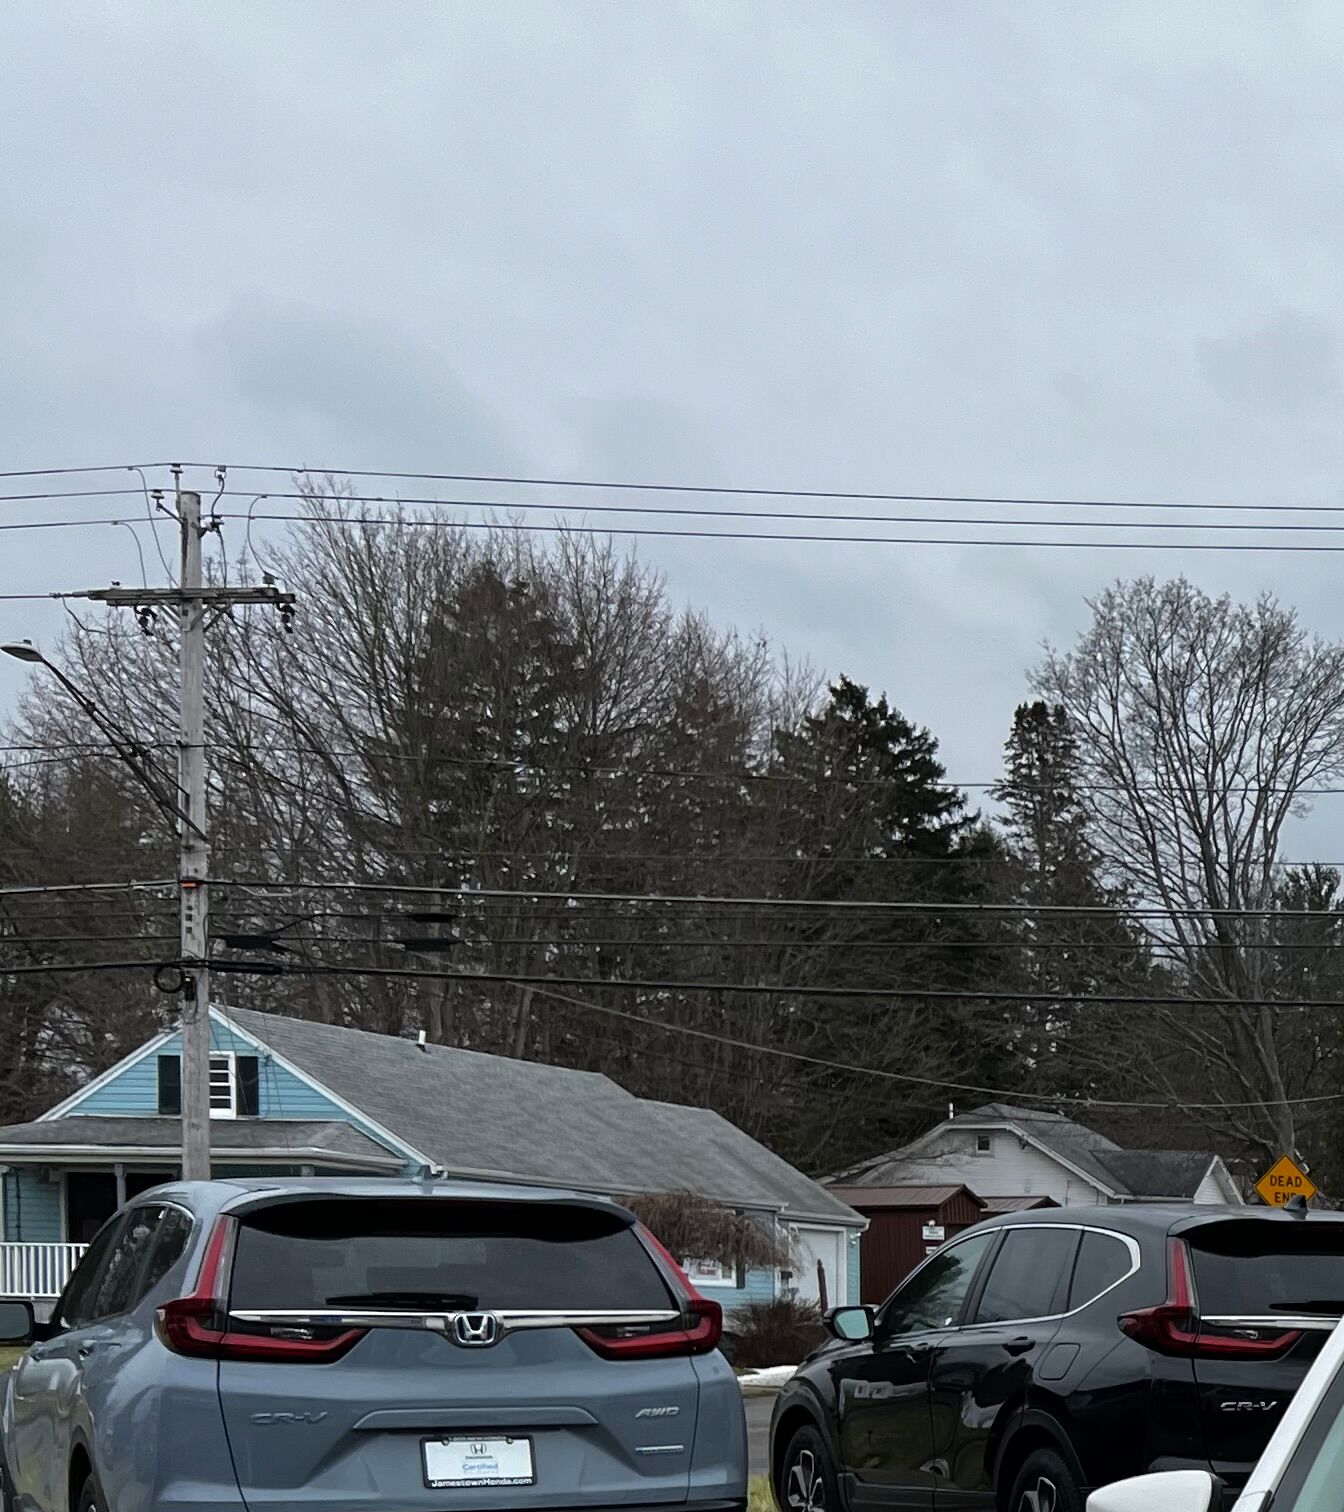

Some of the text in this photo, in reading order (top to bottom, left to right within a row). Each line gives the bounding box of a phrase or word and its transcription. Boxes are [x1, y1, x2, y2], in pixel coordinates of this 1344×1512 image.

[1270, 1175, 1302, 1187] DEAD
[1274, 1192, 1296, 1203] EN
[635, 1406, 679, 1418] AWD
[1220, 1401, 1277, 1411] CR-V
[250, 1411, 328, 1424] CR-V
